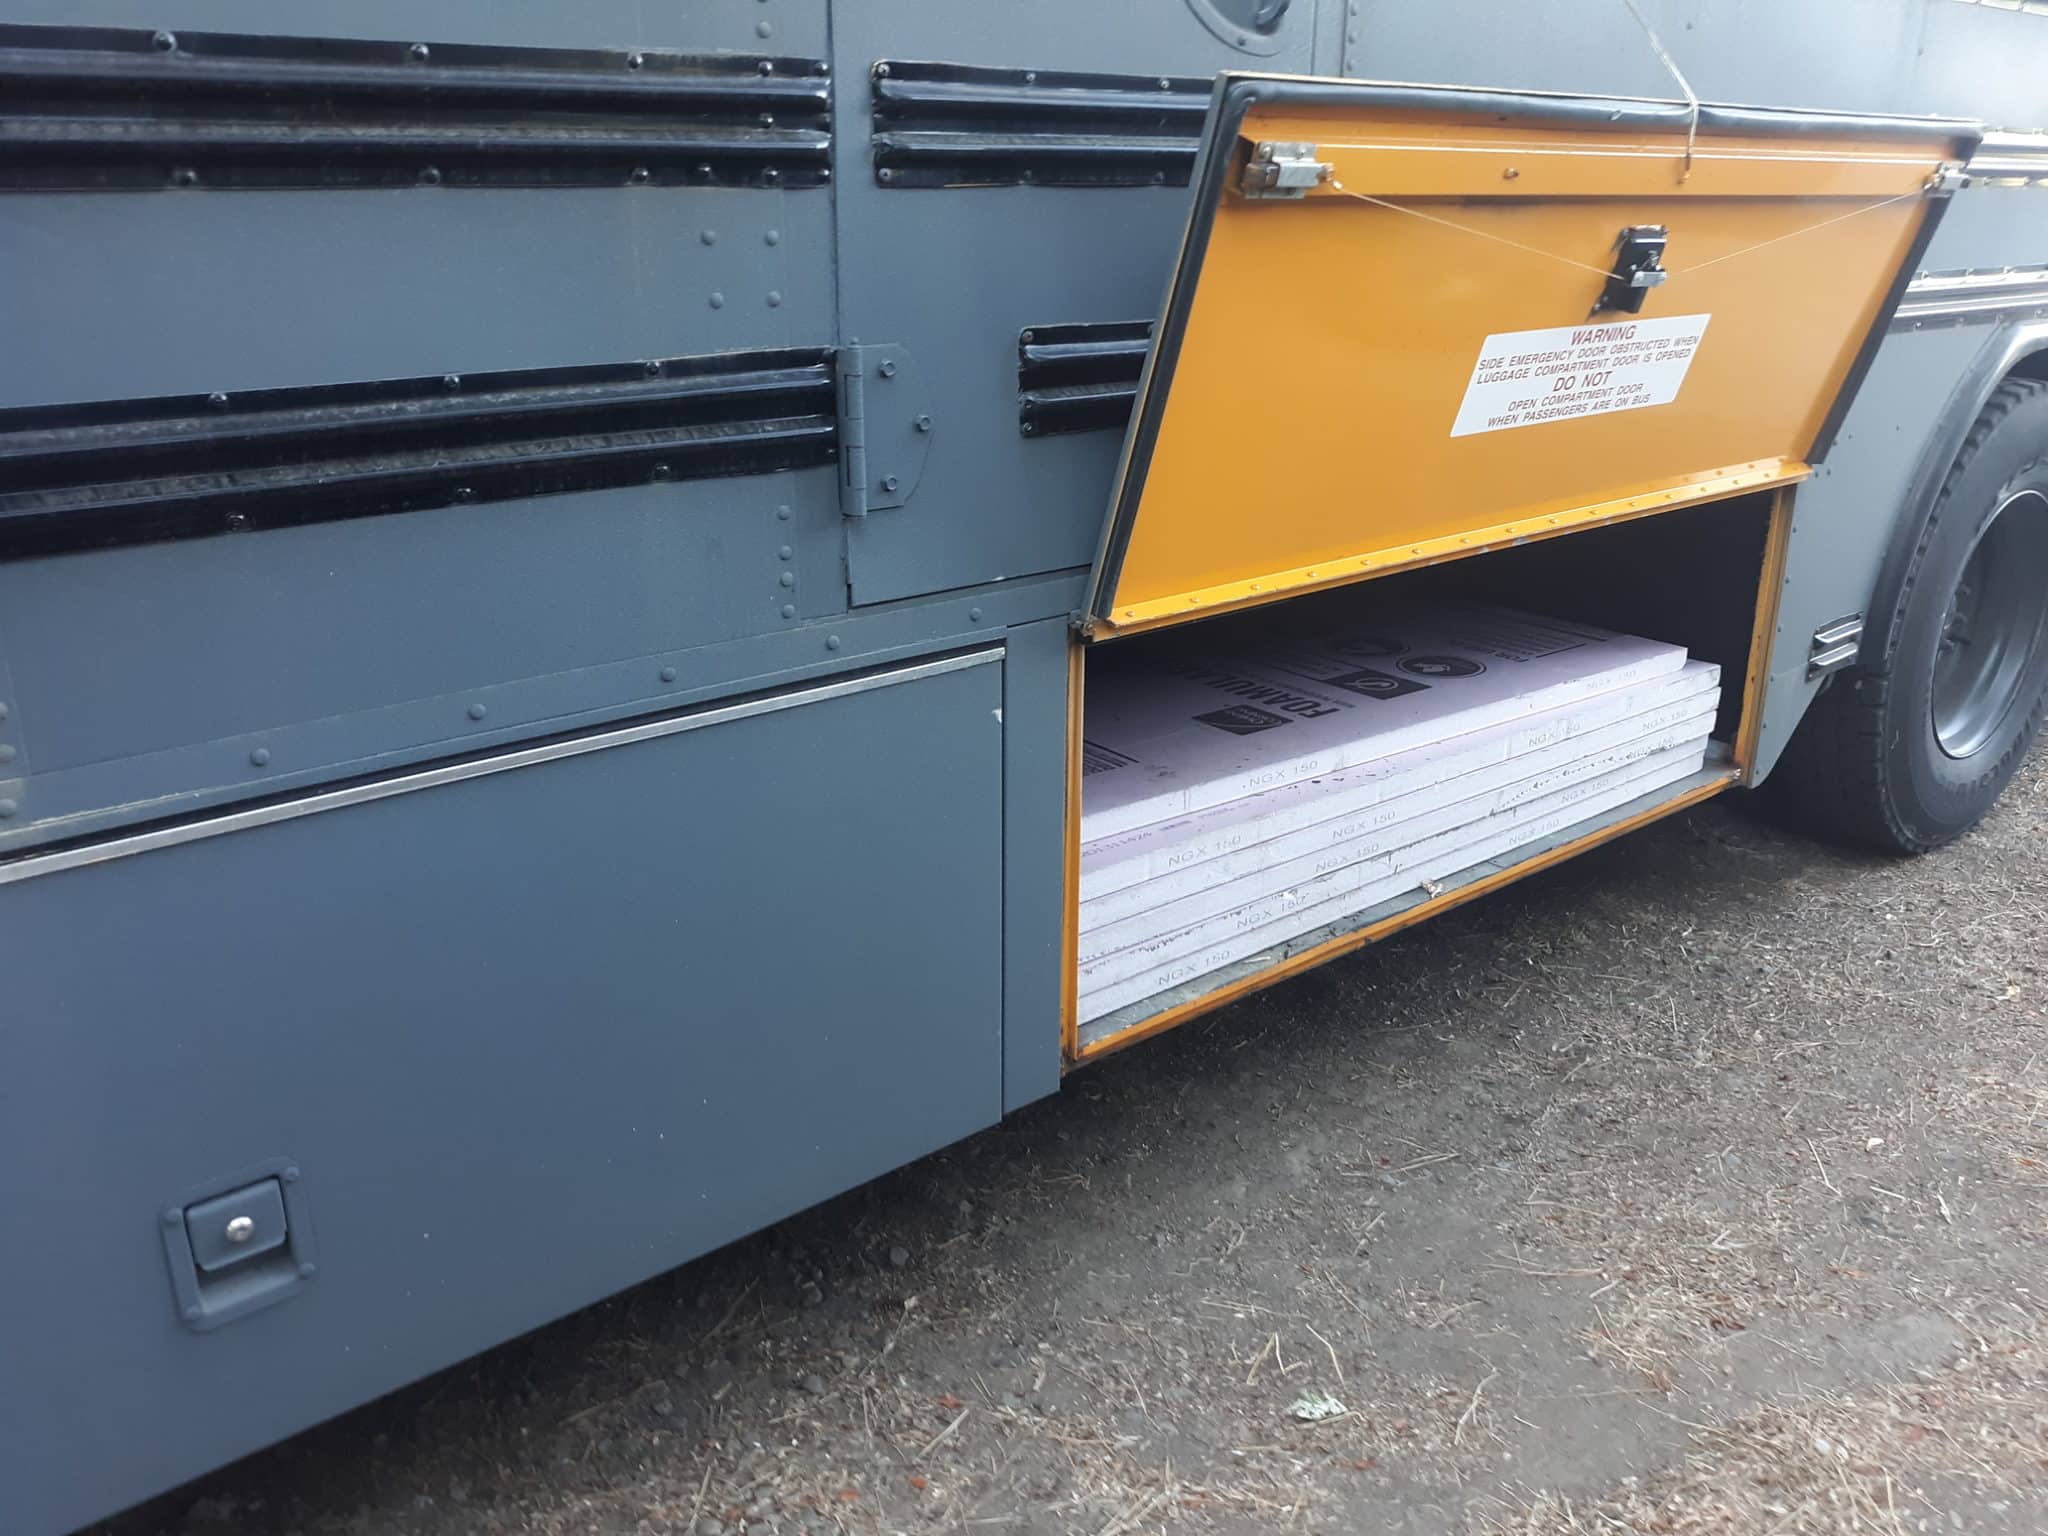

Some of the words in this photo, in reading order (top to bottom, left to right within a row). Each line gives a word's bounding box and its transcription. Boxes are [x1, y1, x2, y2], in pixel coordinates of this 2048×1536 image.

[1570, 325, 1637, 346] WARNING
[1477, 369, 1529, 384] LUGGAGE
[1534, 359, 1609, 377] COMPARTMENT
[1612, 355, 1639, 367] DOOR
[1643, 353, 1652, 363] IS
[1654, 348, 1692, 361] OPENED
[1478, 357, 1505, 370] SIDE
[1509, 350, 1573, 367] EMERGENCY
[1577, 345, 1606, 359] DOOR
[1610, 339, 1669, 355] OBSTRUCTED
[1673, 335, 1699, 347] WHEN
[1553, 377, 1576, 392] DO
[1581, 371, 1613, 387] NOT
[1487, 413, 1518, 427] WHEN
[1522, 403, 1588, 422] PASSENGERS
[1592, 400, 1611, 411] ARE
[1614, 397, 1629, 408] ON
[1631, 394, 1651, 405] BUS
[1508, 399, 1538, 412] OPEN
[1541, 388, 1614, 407] COMPARTMENT
[1616, 383, 1643, 395] DOOR
[1173, 665, 1340, 719] FOAMUL
[1249, 768, 1287, 786] NGX
[1294, 760, 1318, 774] 150
[1332, 820, 1367, 840] NGX
[1374, 810, 1397, 825] 150
[1168, 846, 1208, 866] NGX
[1215, 835, 1241, 850] 150
[1315, 853, 1352, 872] NGX
[1358, 843, 1380, 858] 150
[1236, 908, 1273, 928] NGX
[1158, 964, 1197, 986] NGX
[1206, 950, 1231, 967] 150
